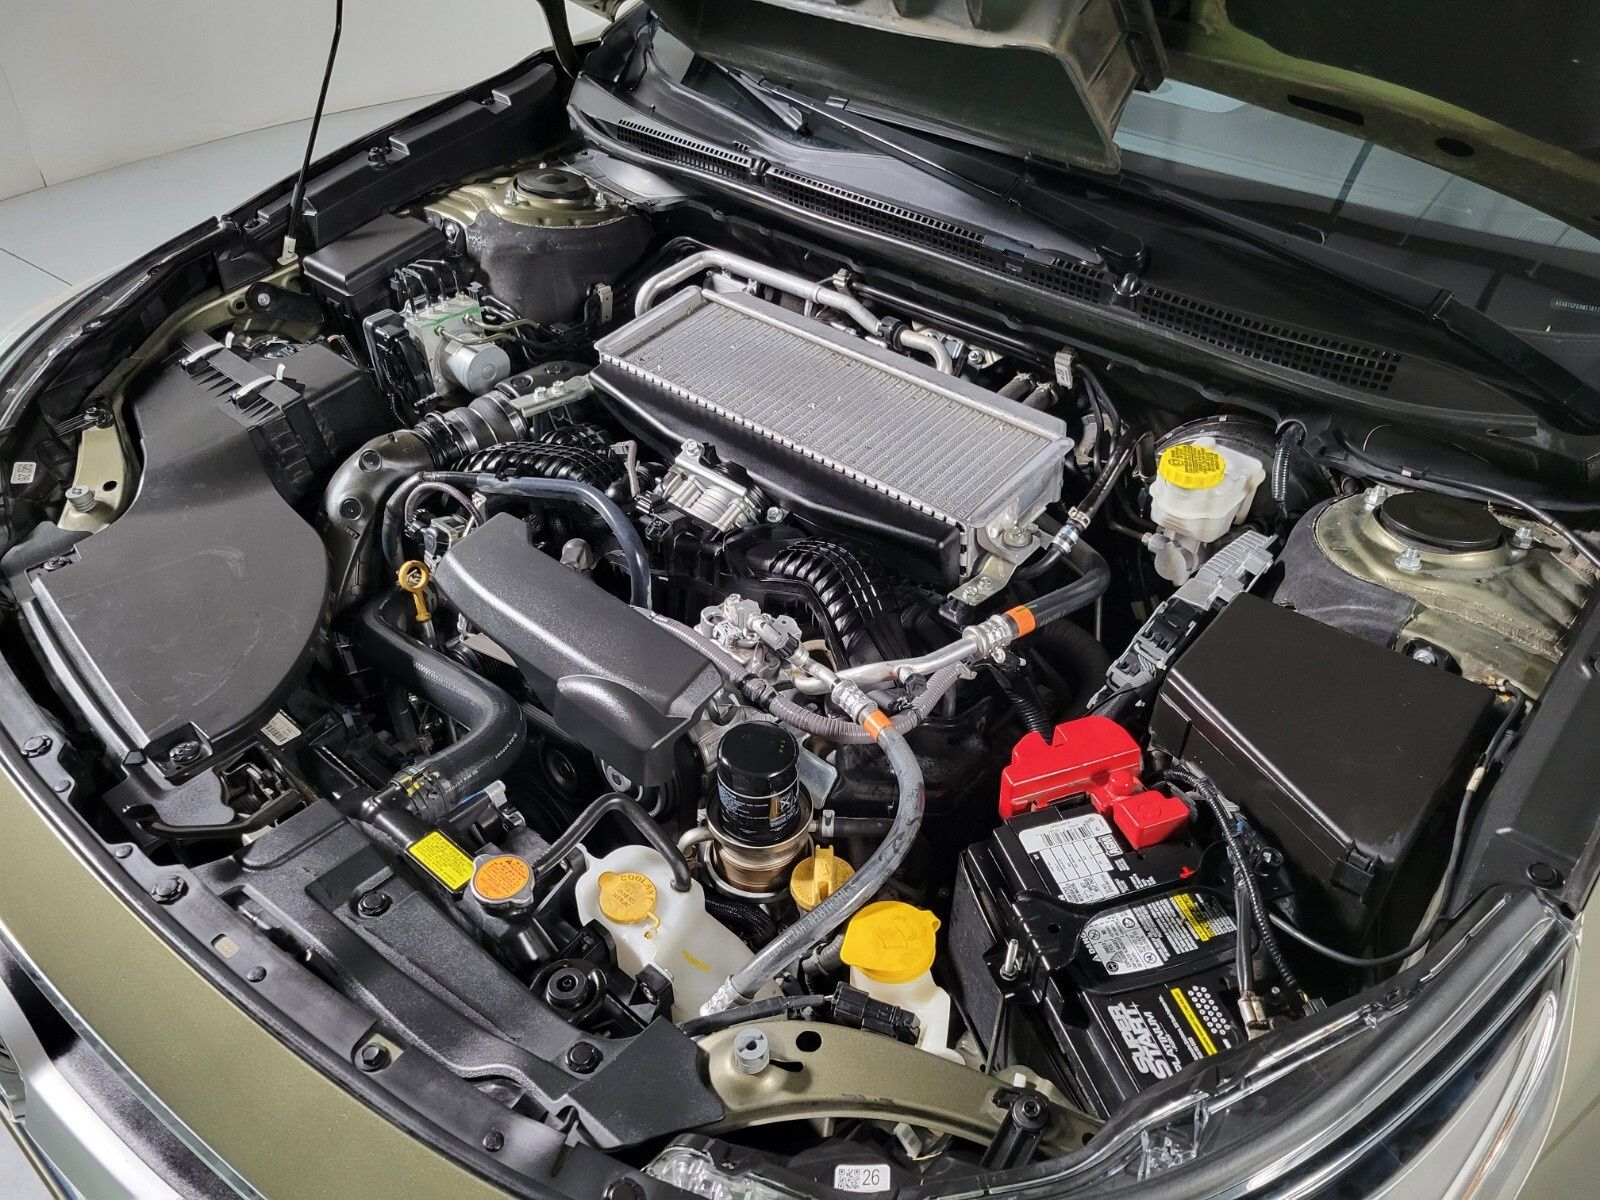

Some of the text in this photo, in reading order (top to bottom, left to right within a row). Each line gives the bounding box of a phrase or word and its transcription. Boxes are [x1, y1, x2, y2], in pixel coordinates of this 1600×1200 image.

[1080, 932, 1095, 954] DANG
[1108, 1006, 1149, 1073] SUPER
[1118, 1002, 1173, 1079] START
[1143, 1012, 1182, 1072] PLATINUM
[863, 1169, 880, 1186] 26
